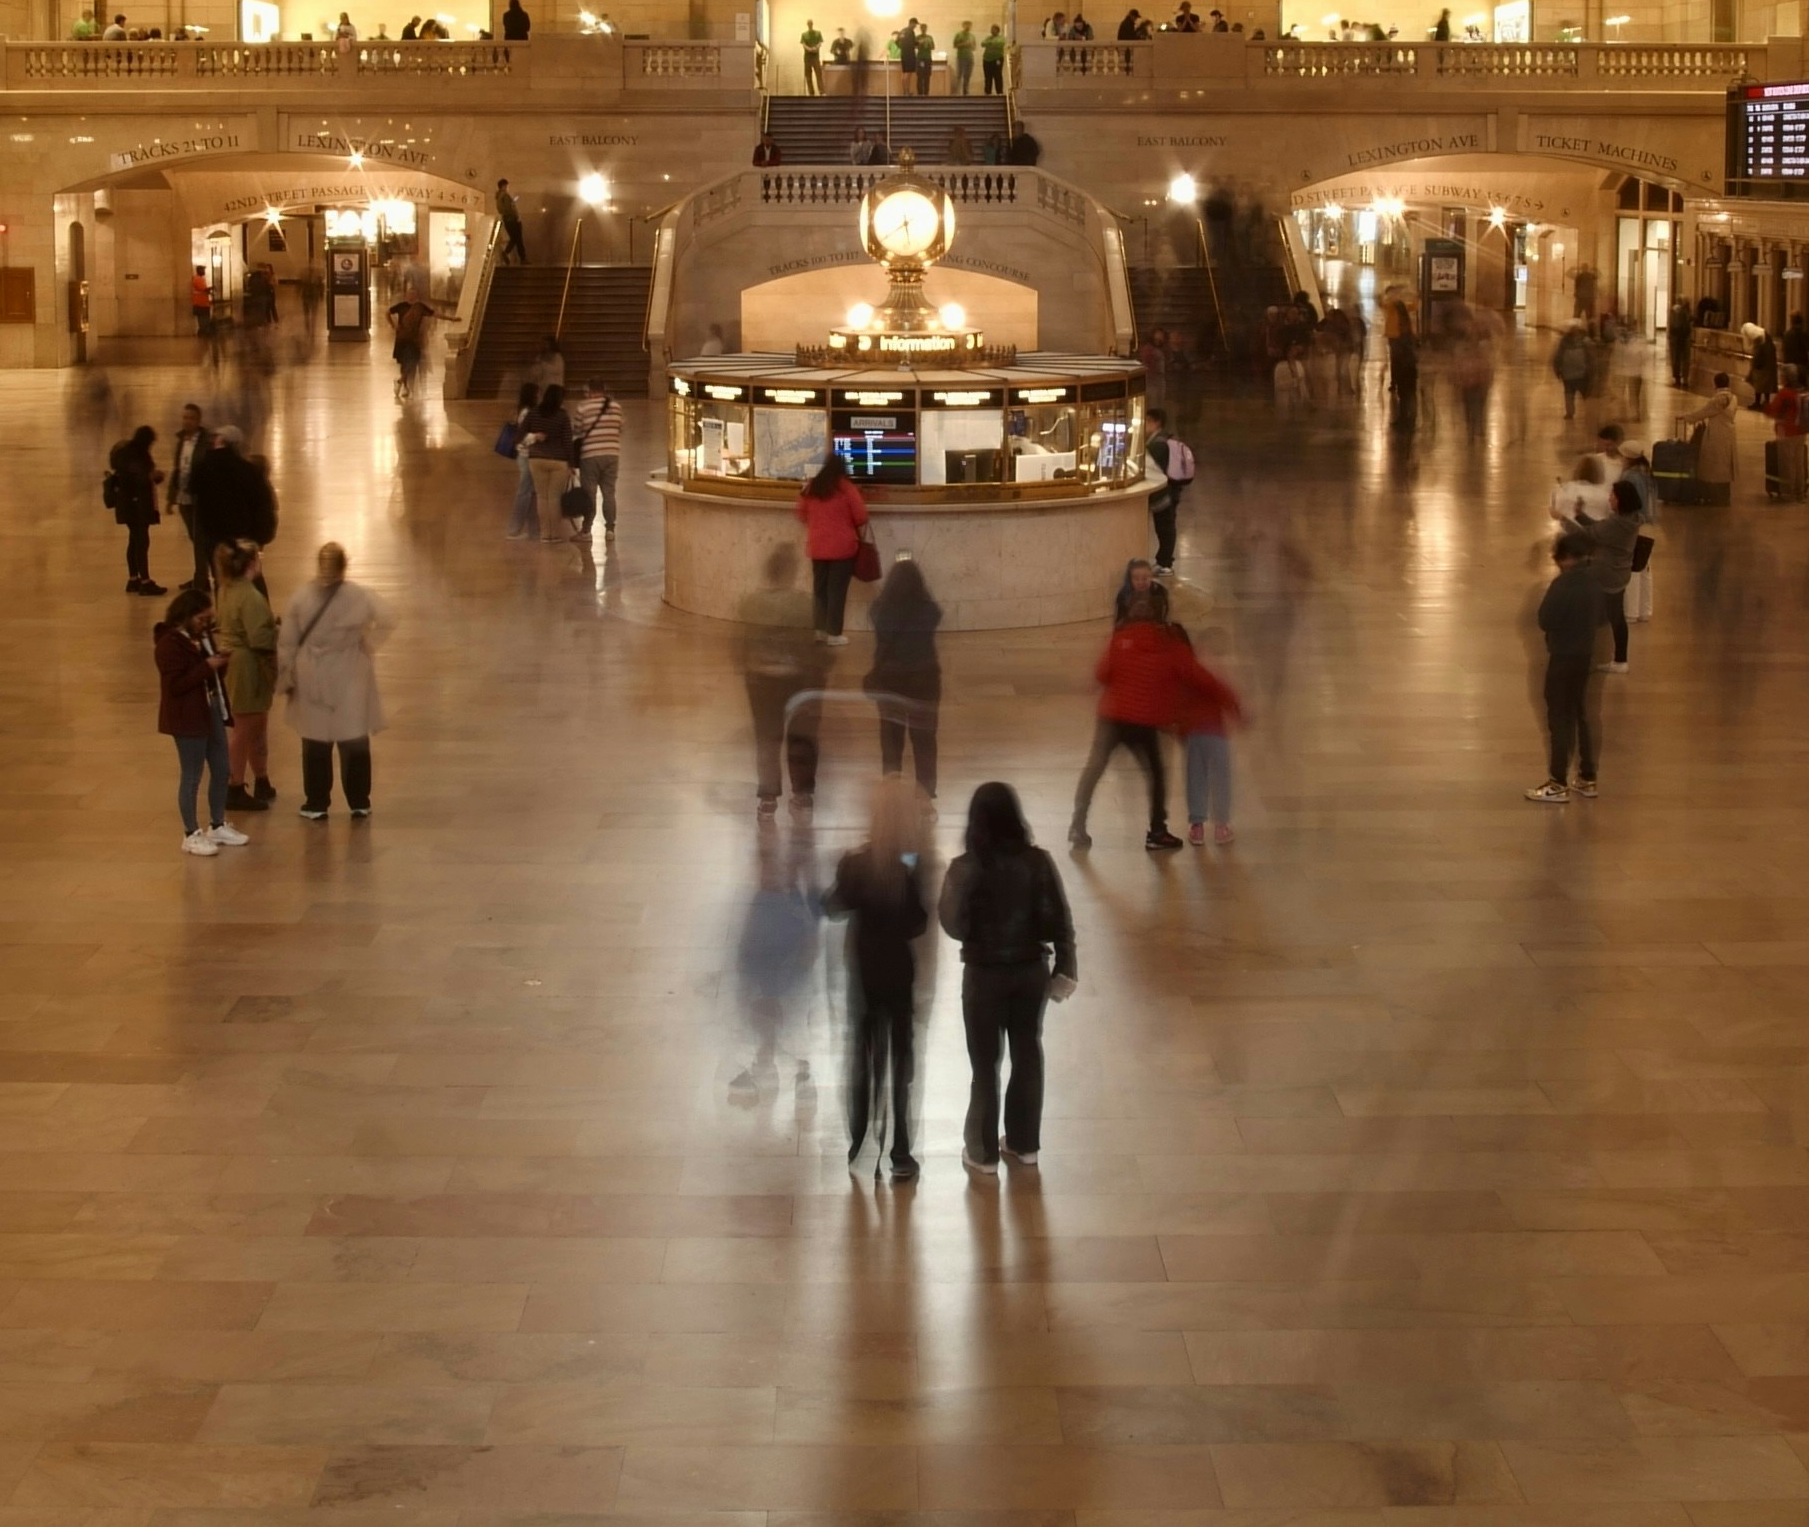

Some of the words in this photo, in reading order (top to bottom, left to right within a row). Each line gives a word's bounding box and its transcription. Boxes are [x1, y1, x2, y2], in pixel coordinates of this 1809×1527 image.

[550, 136, 577, 145] EAST
[582, 136, 638, 145] BALCONY
[1137, 136, 1166, 147] EAST
[1170, 136, 1227, 147] BALCONY
[118, 141, 180, 166] TRACKS
[182, 140, 200, 155] 21
[202, 137, 225, 151] TO
[227, 135, 239, 148] 11
[398, 148, 429, 166] AVE
[1349, 138, 1443, 167] LEXINGTON
[1448, 135, 1478, 149] AVE
[1537, 135, 1591, 153] TICKET
[1598, 142, 1678, 172] MACHINES
[1424, 185, 1482, 200] SUBWAY
[224, 196, 258, 211] 42ND
[767, 258, 809, 274] TRACKS
[966, 258, 1030, 281] CONCOURSE
[880, 335, 955, 351] Information
